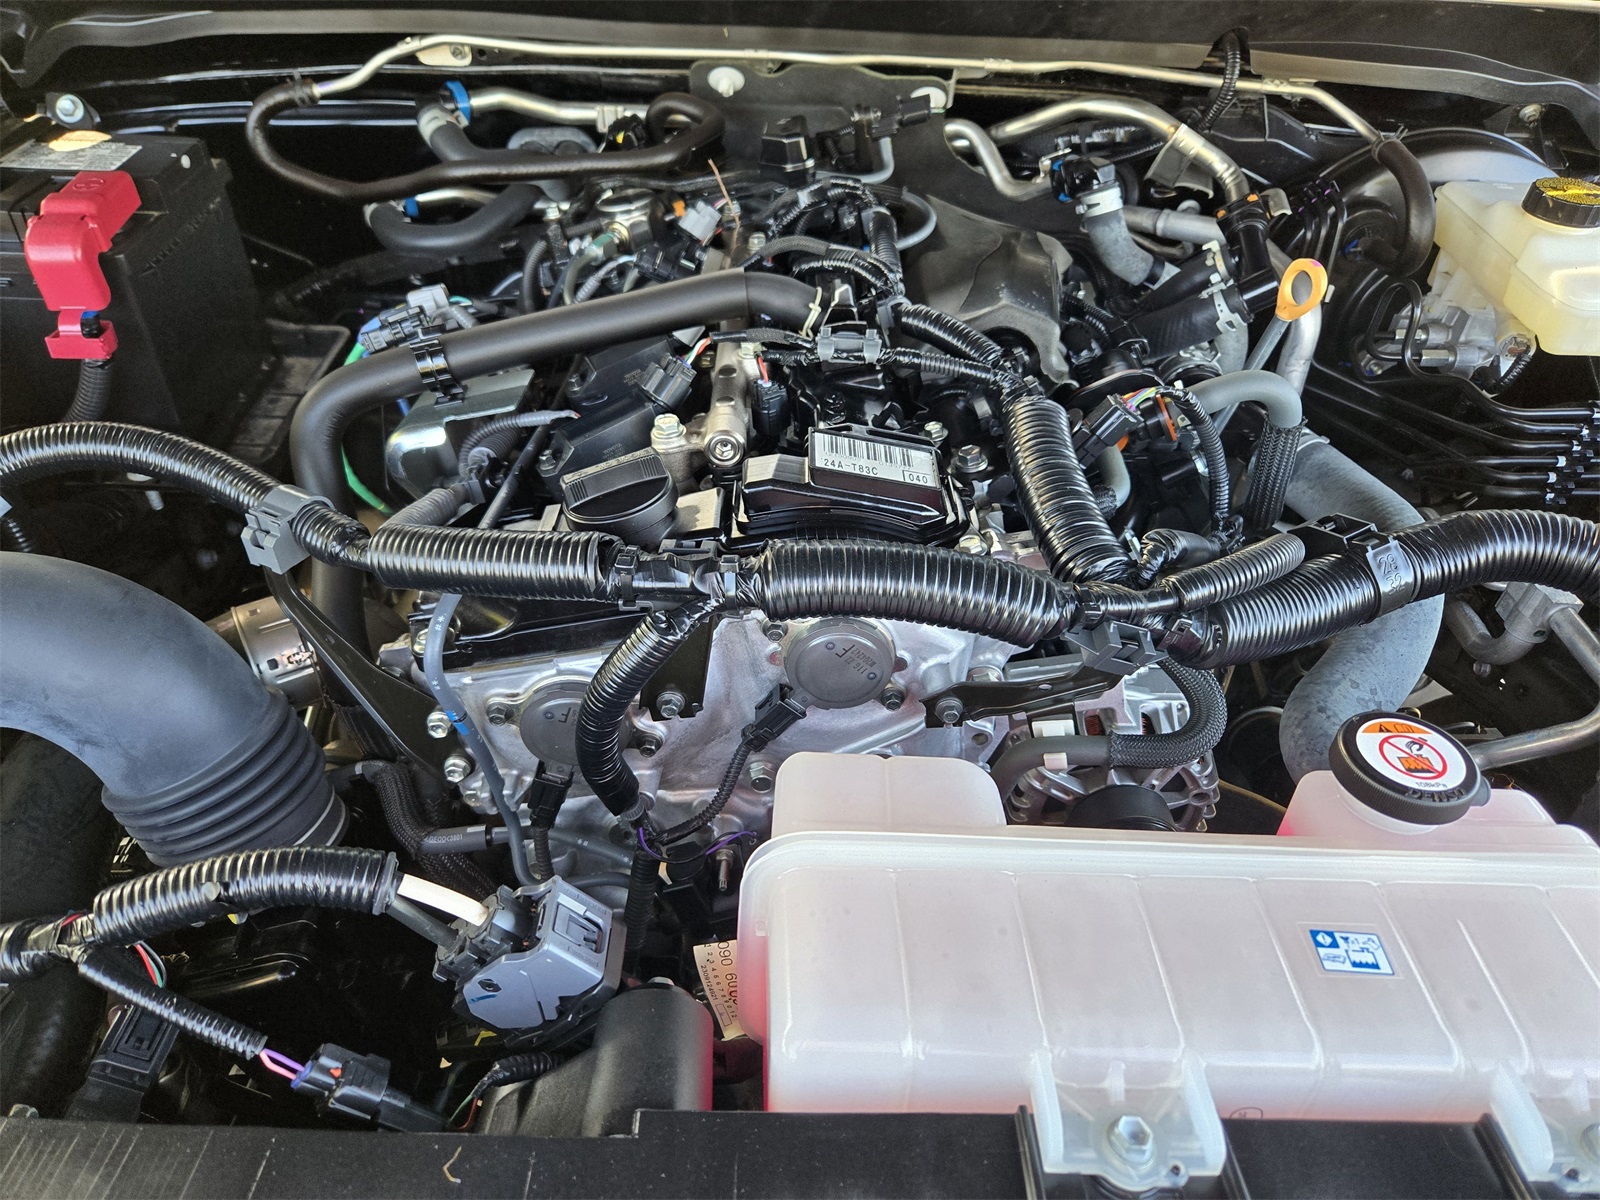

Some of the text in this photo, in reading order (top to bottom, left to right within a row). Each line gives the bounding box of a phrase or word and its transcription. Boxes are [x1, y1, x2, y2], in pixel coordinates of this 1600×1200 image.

[823, 458, 879, 476] 24A-T83C
[908, 474, 928, 484] 040
[1378, 553, 1398, 575] 28
[1403, 787, 1467, 803] DENSO
